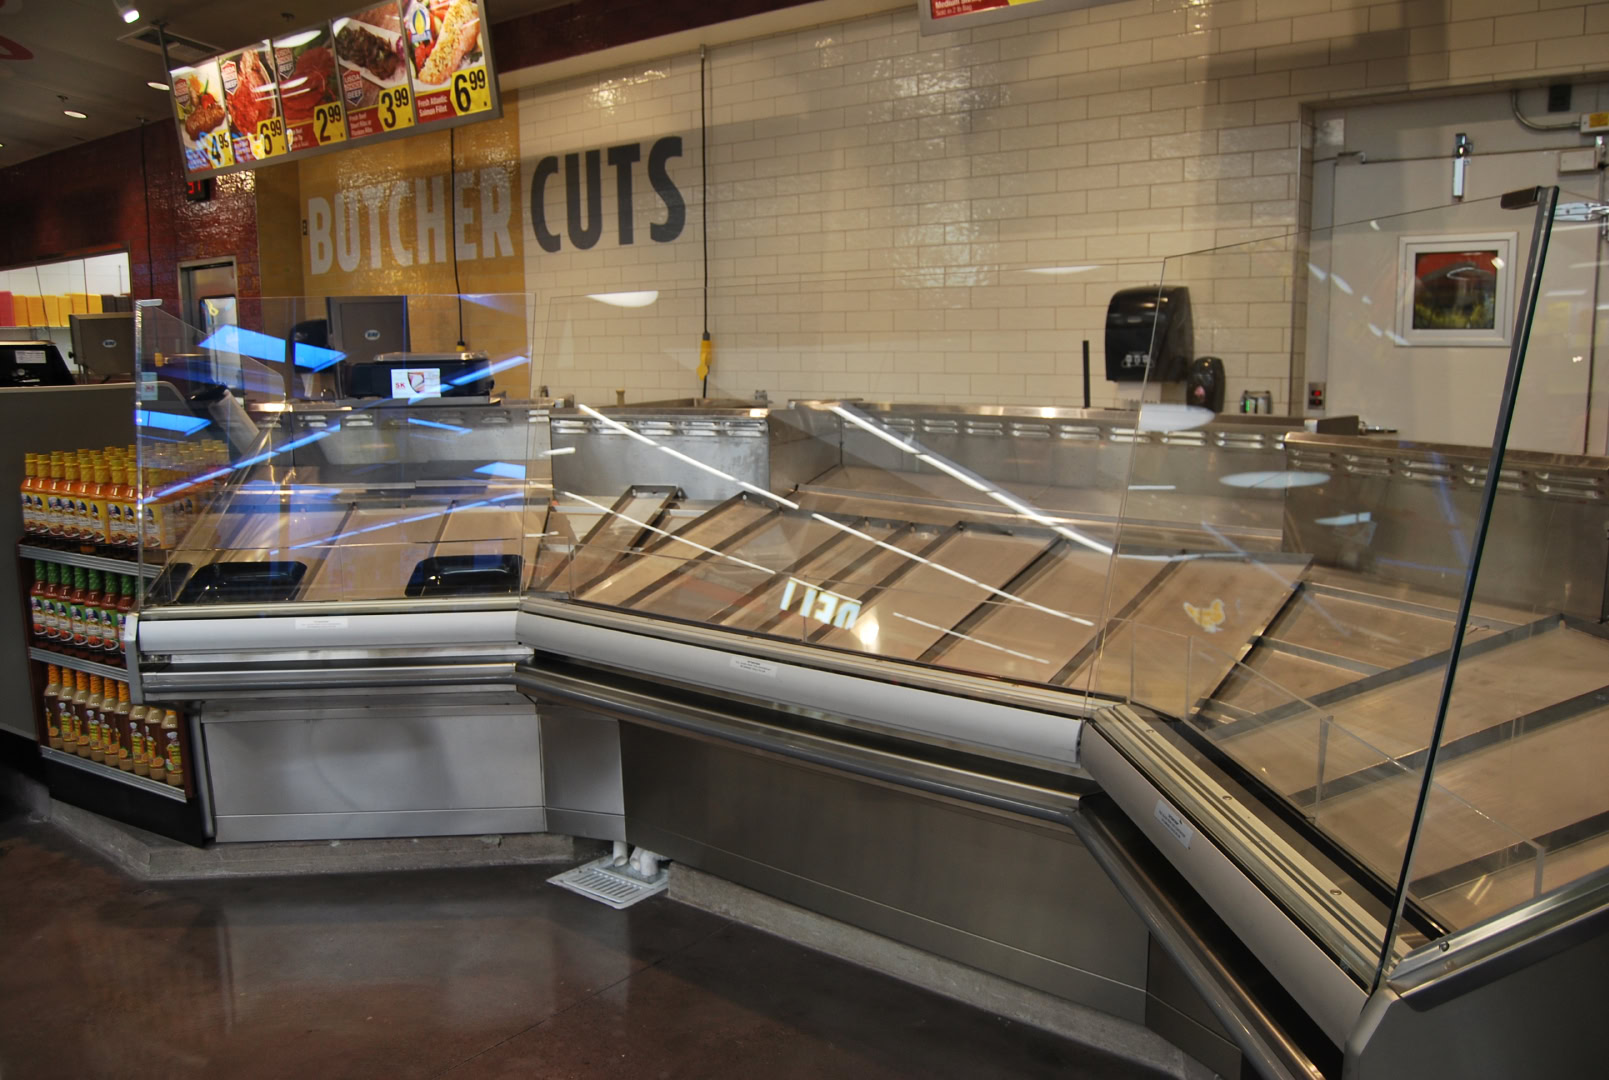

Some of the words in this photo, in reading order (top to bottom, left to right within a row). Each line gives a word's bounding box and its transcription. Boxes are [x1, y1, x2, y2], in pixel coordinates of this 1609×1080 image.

[417, 97, 430, 107] Fresh
[418, 107, 435, 117] Salmon
[307, 167, 514, 275] BUTCHER
[531, 136, 688, 254] CUTS
